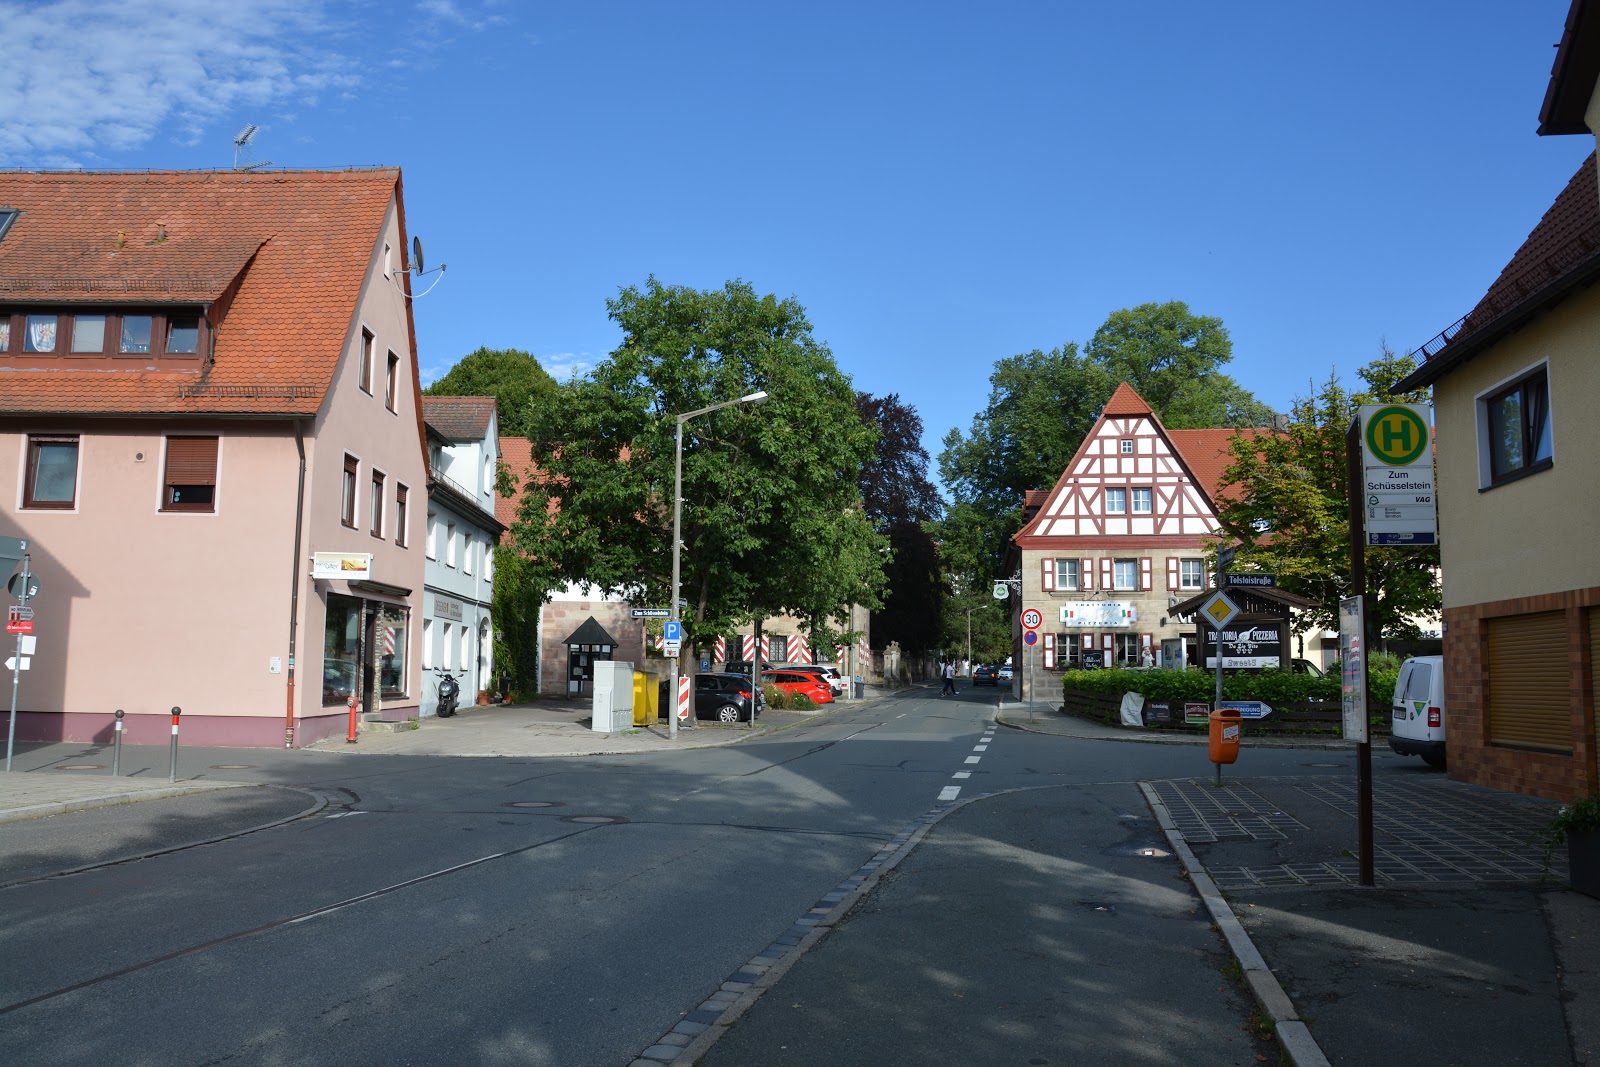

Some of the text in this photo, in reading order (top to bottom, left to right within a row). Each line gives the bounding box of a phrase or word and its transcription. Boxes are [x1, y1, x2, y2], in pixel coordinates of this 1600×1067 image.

[1382, 420, 1411, 451] H
[1388, 471, 1409, 479] Zum
[1367, 481, 1431, 491] Schüsselstein
[1229, 576, 1272, 586] Tolstoistraße
[1026, 614, 1038, 624] 30
[668, 624, 676, 638] P
[1252, 630, 1278, 640] PIZZERIA
